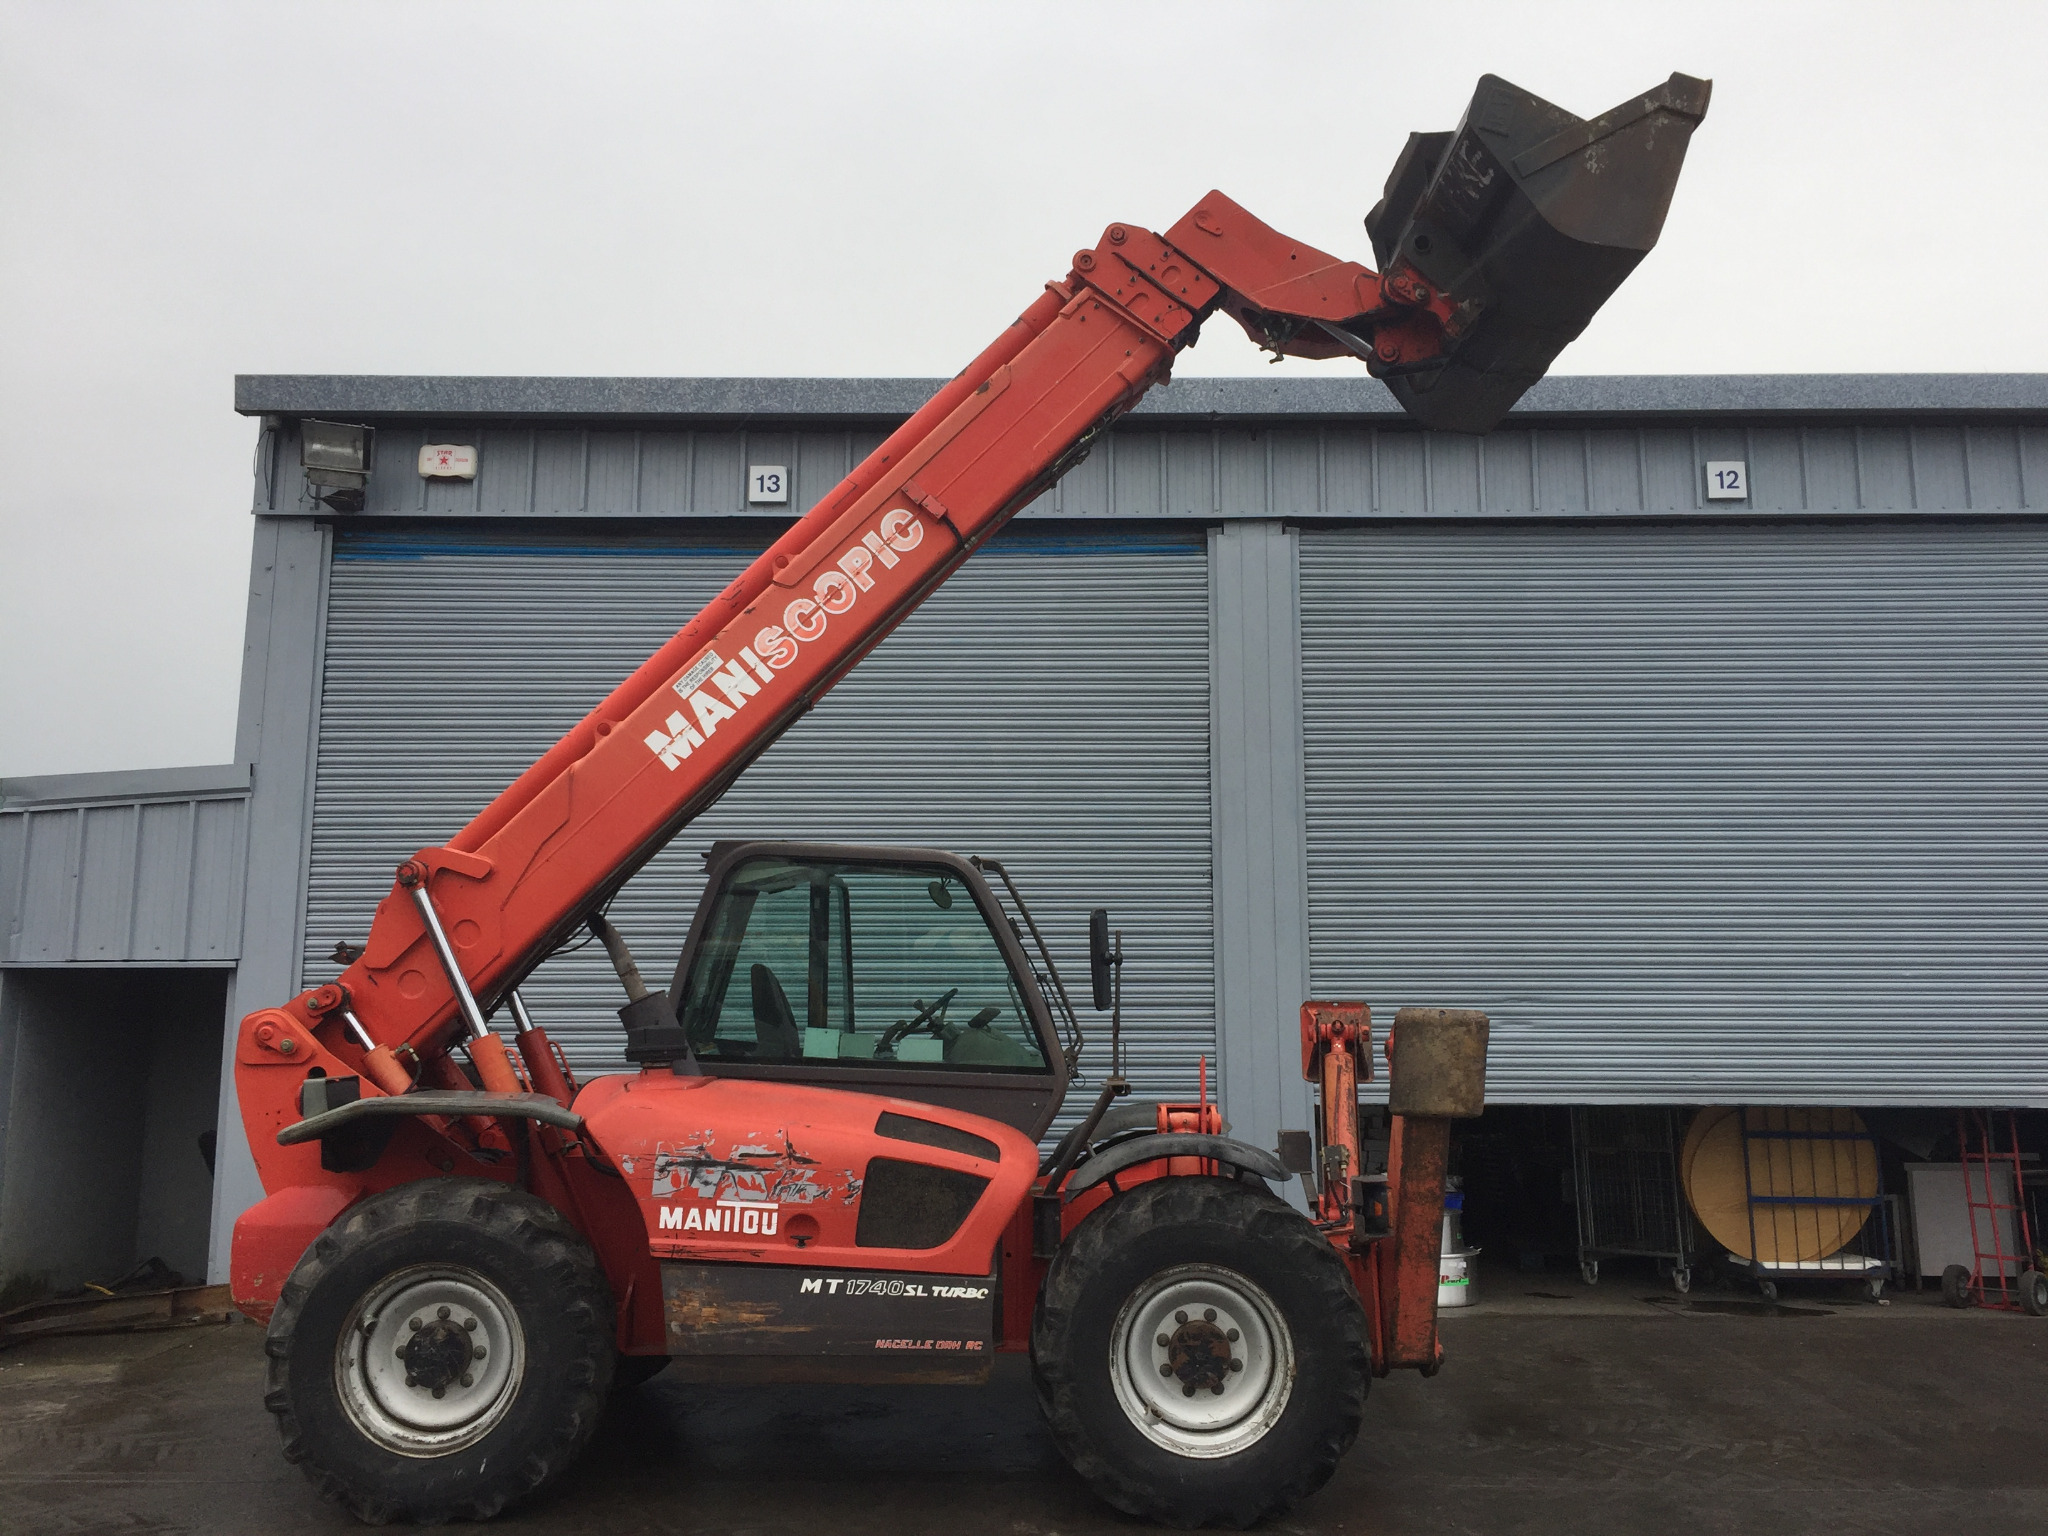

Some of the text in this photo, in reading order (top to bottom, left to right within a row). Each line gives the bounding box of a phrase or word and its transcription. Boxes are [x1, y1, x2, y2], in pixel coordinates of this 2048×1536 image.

[756, 474, 780, 493] 13
[1714, 470, 1740, 489] 12
[643, 508, 924, 772] MANISCOPIC
[682, 665, 699, 681] DAMAGE
[697, 652, 713, 667] CAUSED
[688, 655, 717, 682] RESPONSIBILITY
[658, 1200, 779, 1236] MANITOU
[800, 1278, 844, 1295] MT
